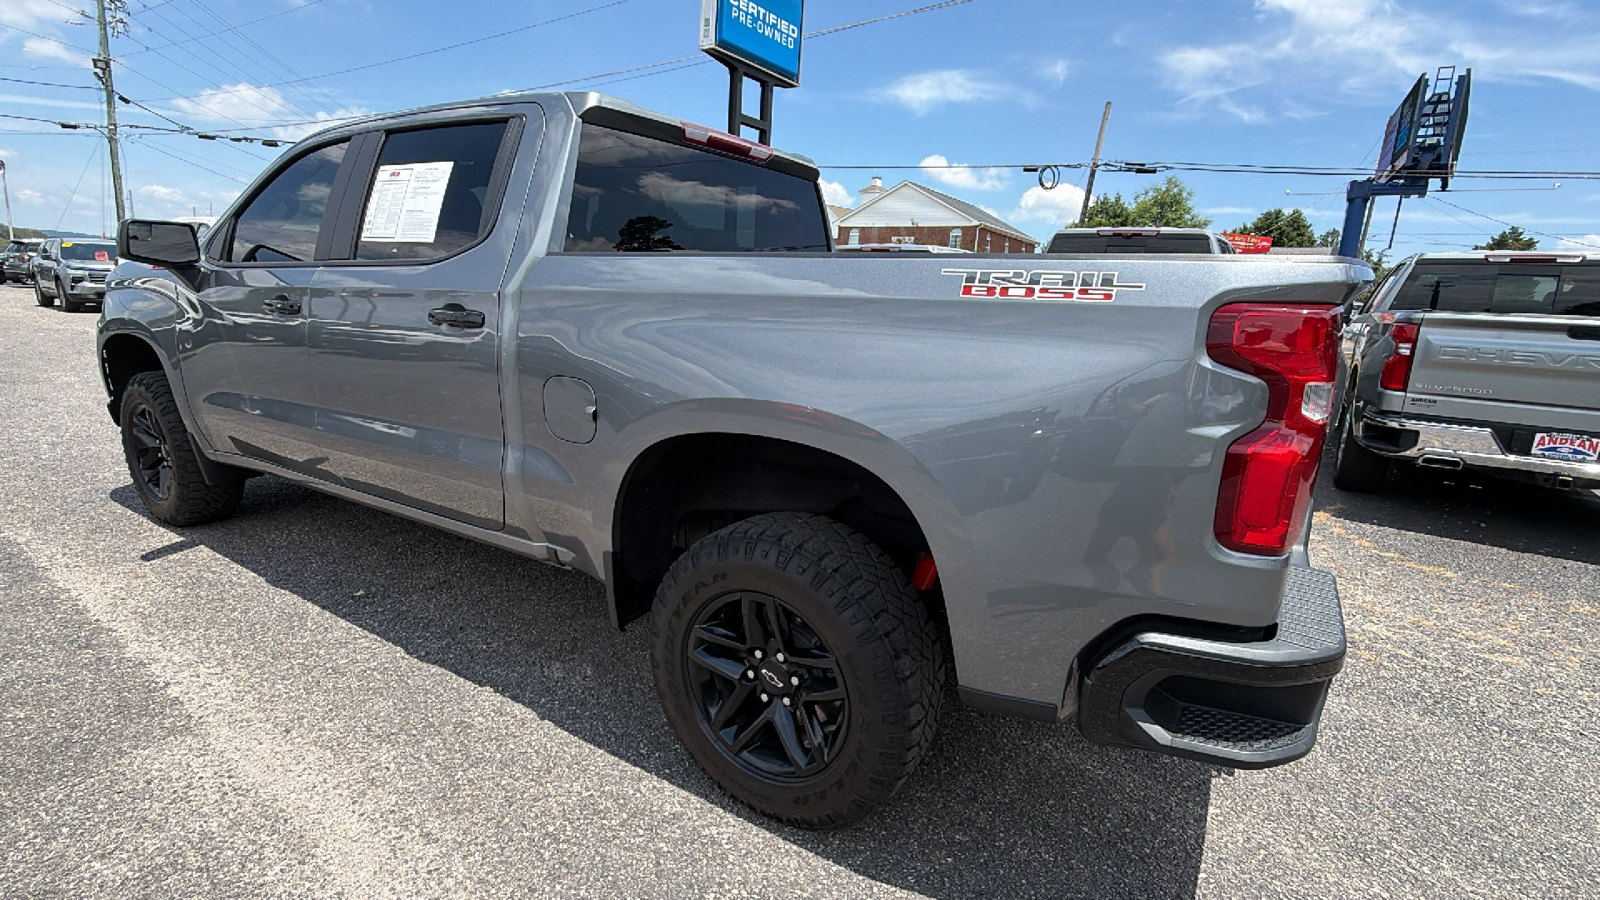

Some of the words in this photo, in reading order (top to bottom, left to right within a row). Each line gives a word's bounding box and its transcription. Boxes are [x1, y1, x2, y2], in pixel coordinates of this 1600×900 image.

[732, 6, 794, 49] PRE-OWNED
[941, 268, 1145, 290] TRAIL
[960, 284, 1116, 301] BOSS
[1414, 382, 1493, 394] SILVERADO
[1535, 435, 1600, 455] ANDEAN
